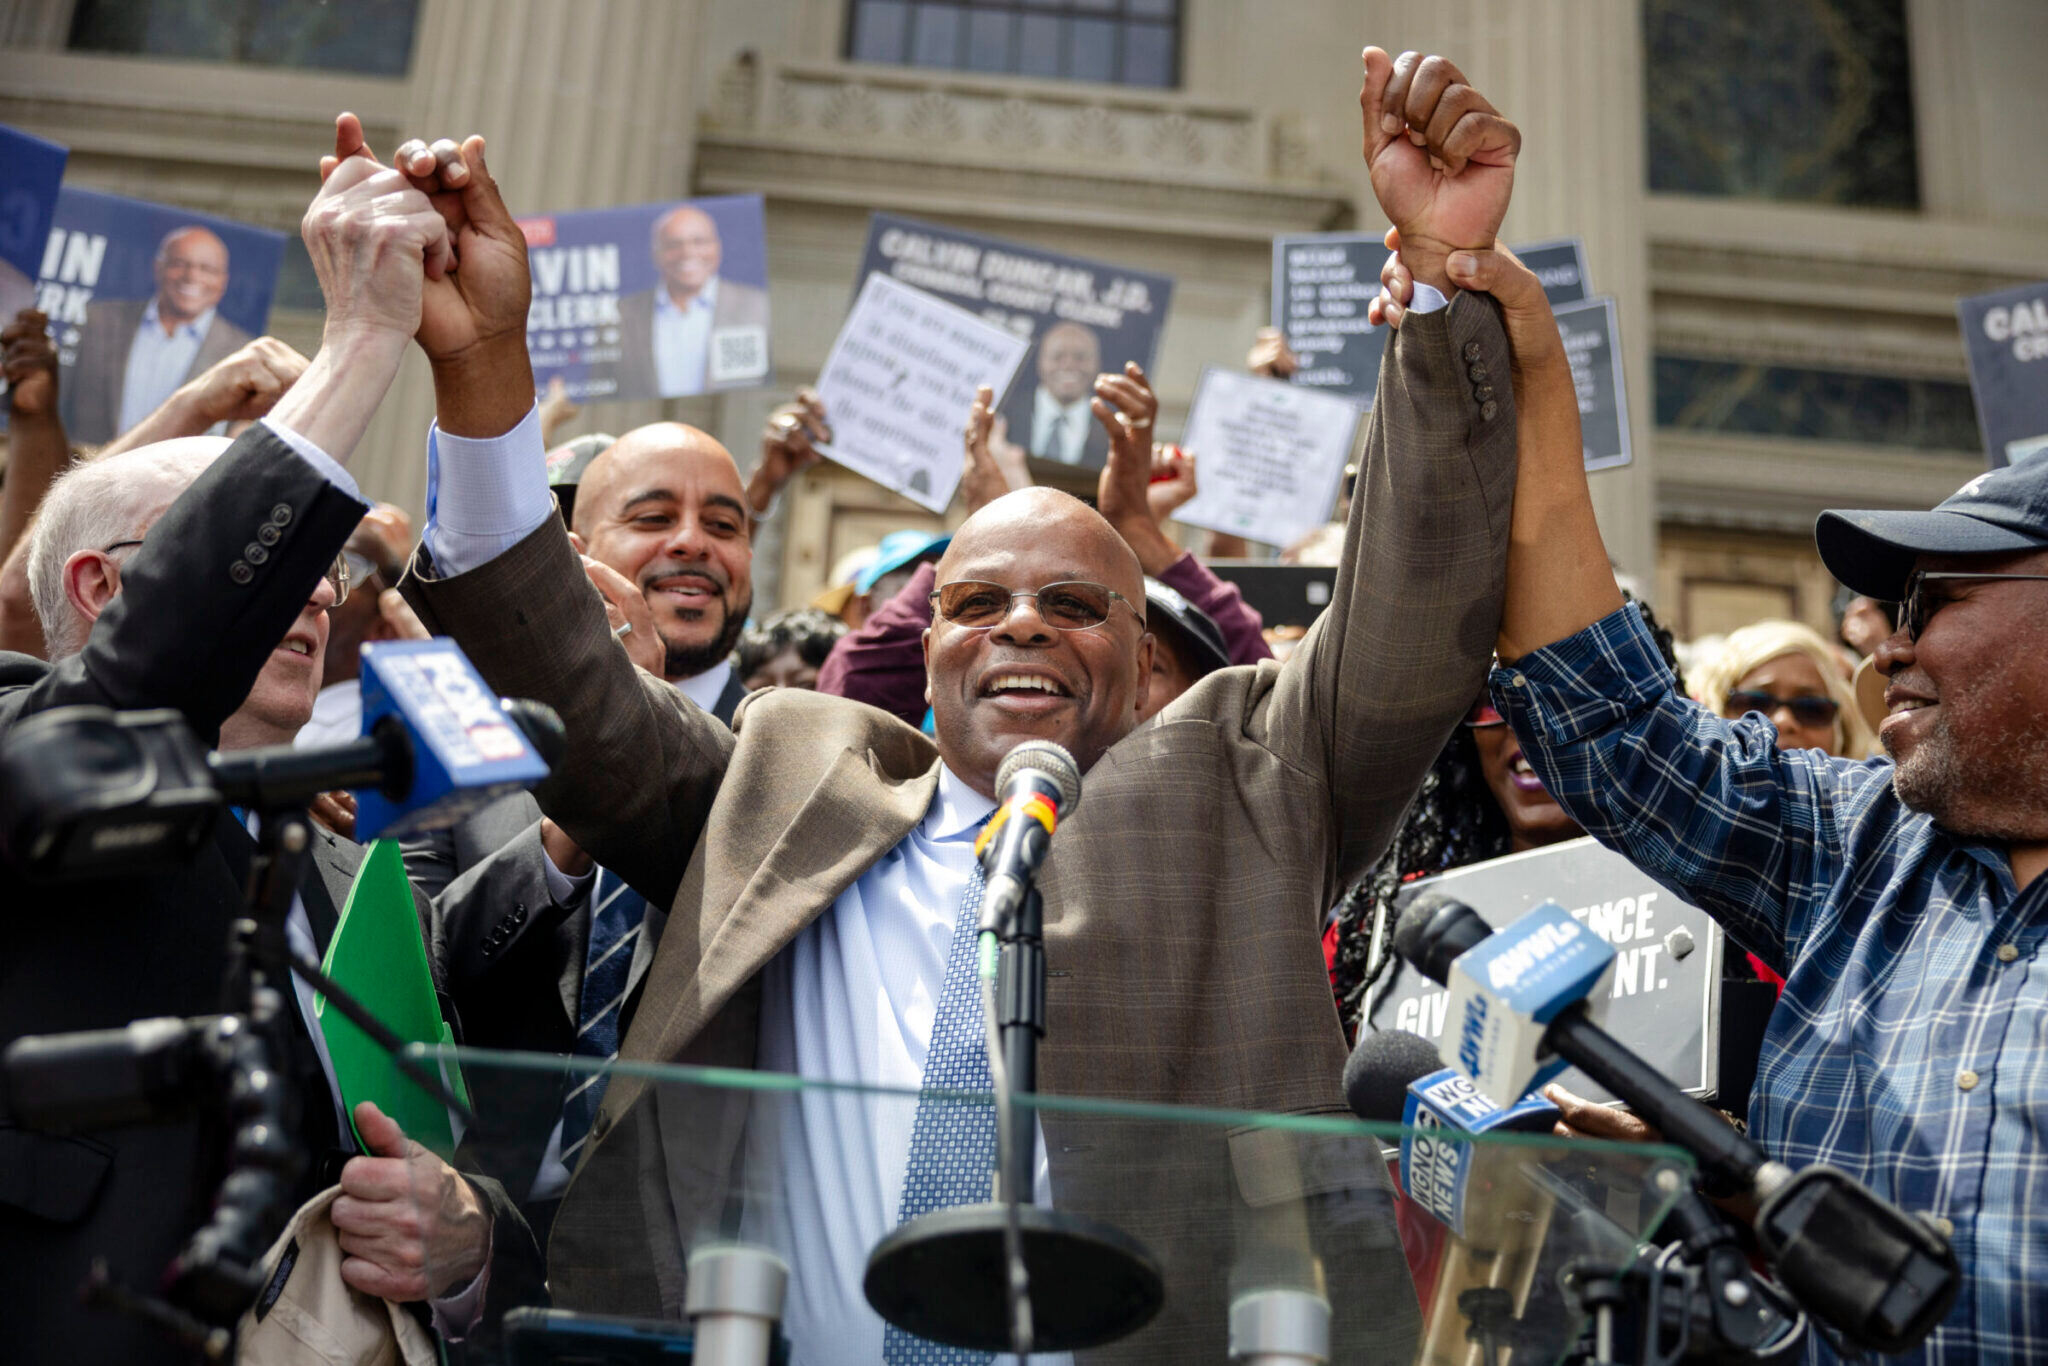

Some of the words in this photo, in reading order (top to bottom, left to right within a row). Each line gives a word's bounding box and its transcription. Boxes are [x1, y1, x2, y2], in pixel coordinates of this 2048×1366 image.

[532, 243, 620, 296] VIN
[36, 281, 94, 325] RK
[1609, 944, 1668, 999] NT.
[1411, 1135, 1434, 1207] WGNO
[1433, 1142, 1459, 1220] NEWS
